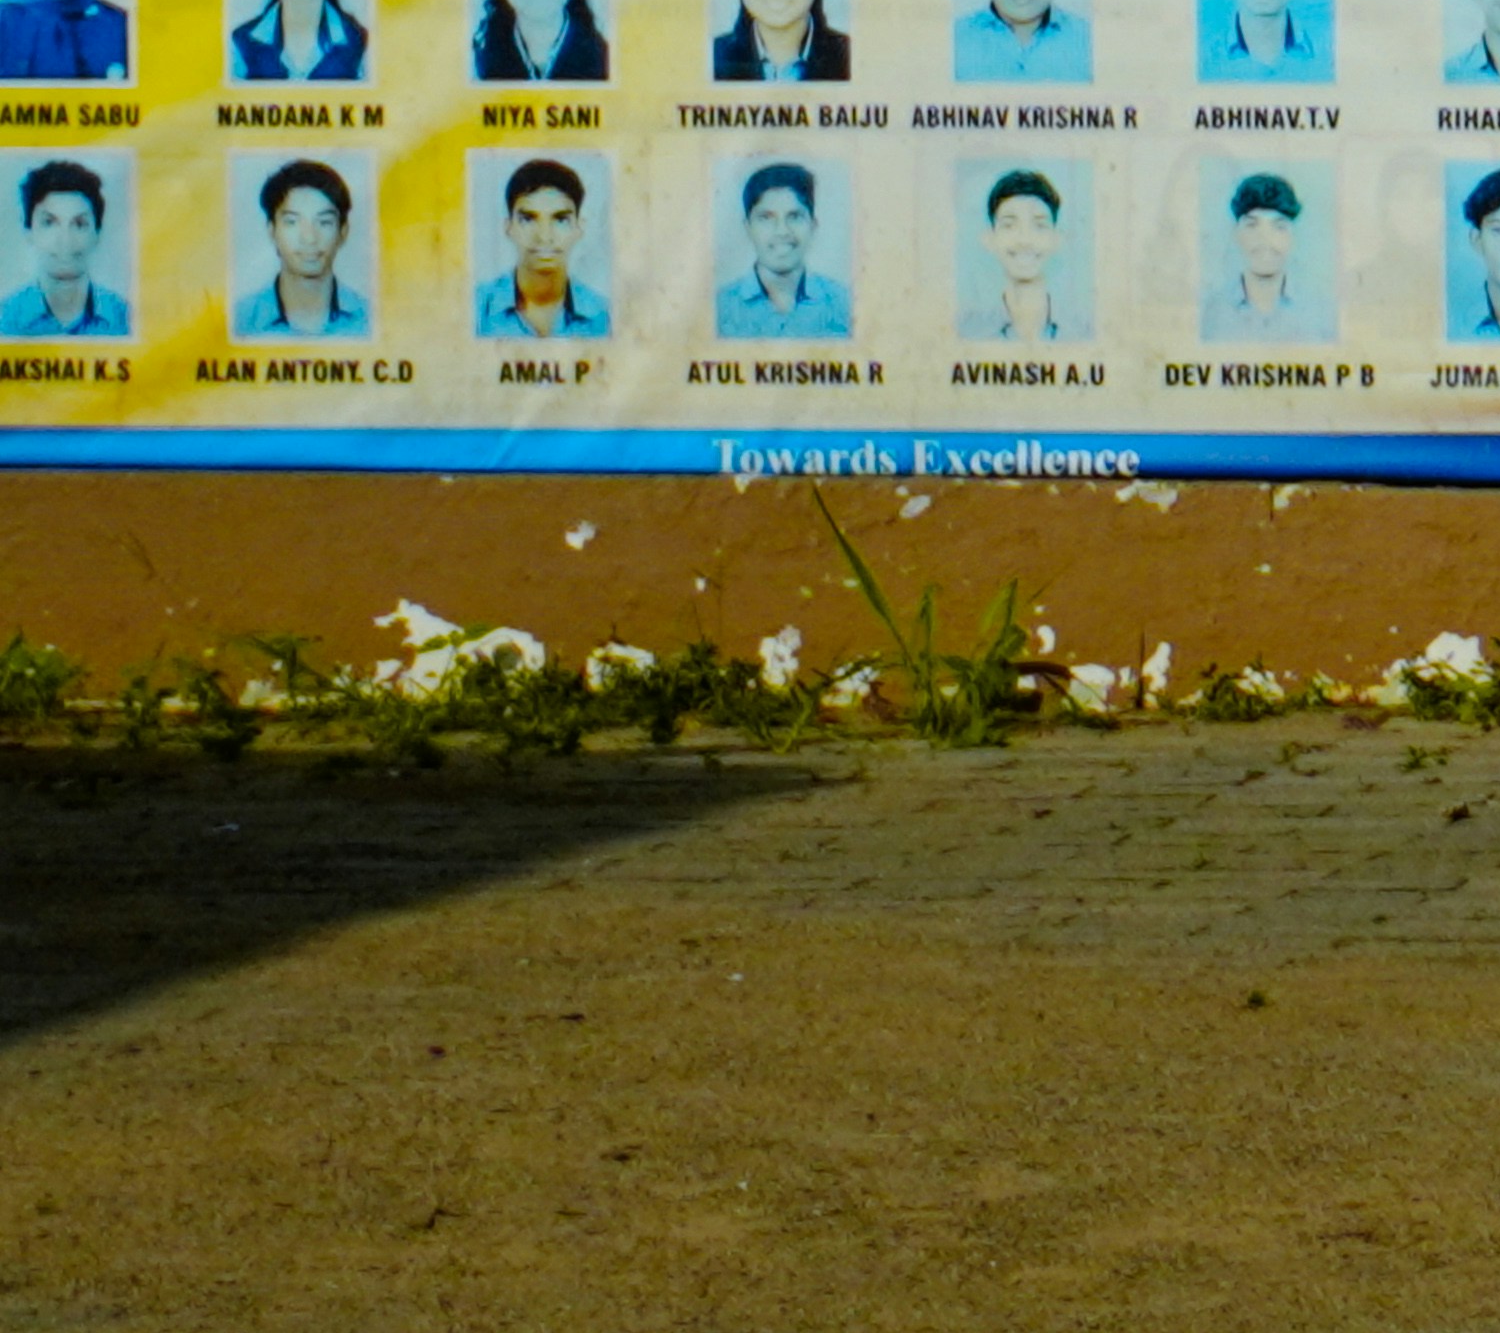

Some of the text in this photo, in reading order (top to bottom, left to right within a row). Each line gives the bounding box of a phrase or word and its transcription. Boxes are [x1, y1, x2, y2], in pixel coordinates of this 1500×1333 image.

[78, 103, 140, 128] SABU
[217, 104, 384, 128] NANDANA K M
[482, 104, 600, 130] NIYA SANI
[677, 104, 889, 129] TRINAYANA BAIJU
[911, 105, 1138, 130] ABHINAV KRISHNA R
[0, 358, 132, 385] AKSHAI K.S
[195, 358, 256, 383] ALAN
[498, 360, 591, 384] AMAL P
[687, 360, 884, 386] ATUL KRISHNA R
[951, 362, 1105, 387] AVINASH A.U
[1164, 363, 1375, 388] DEV KRISHNA P B
[712, 438, 1141, 478] Towards Excellence
